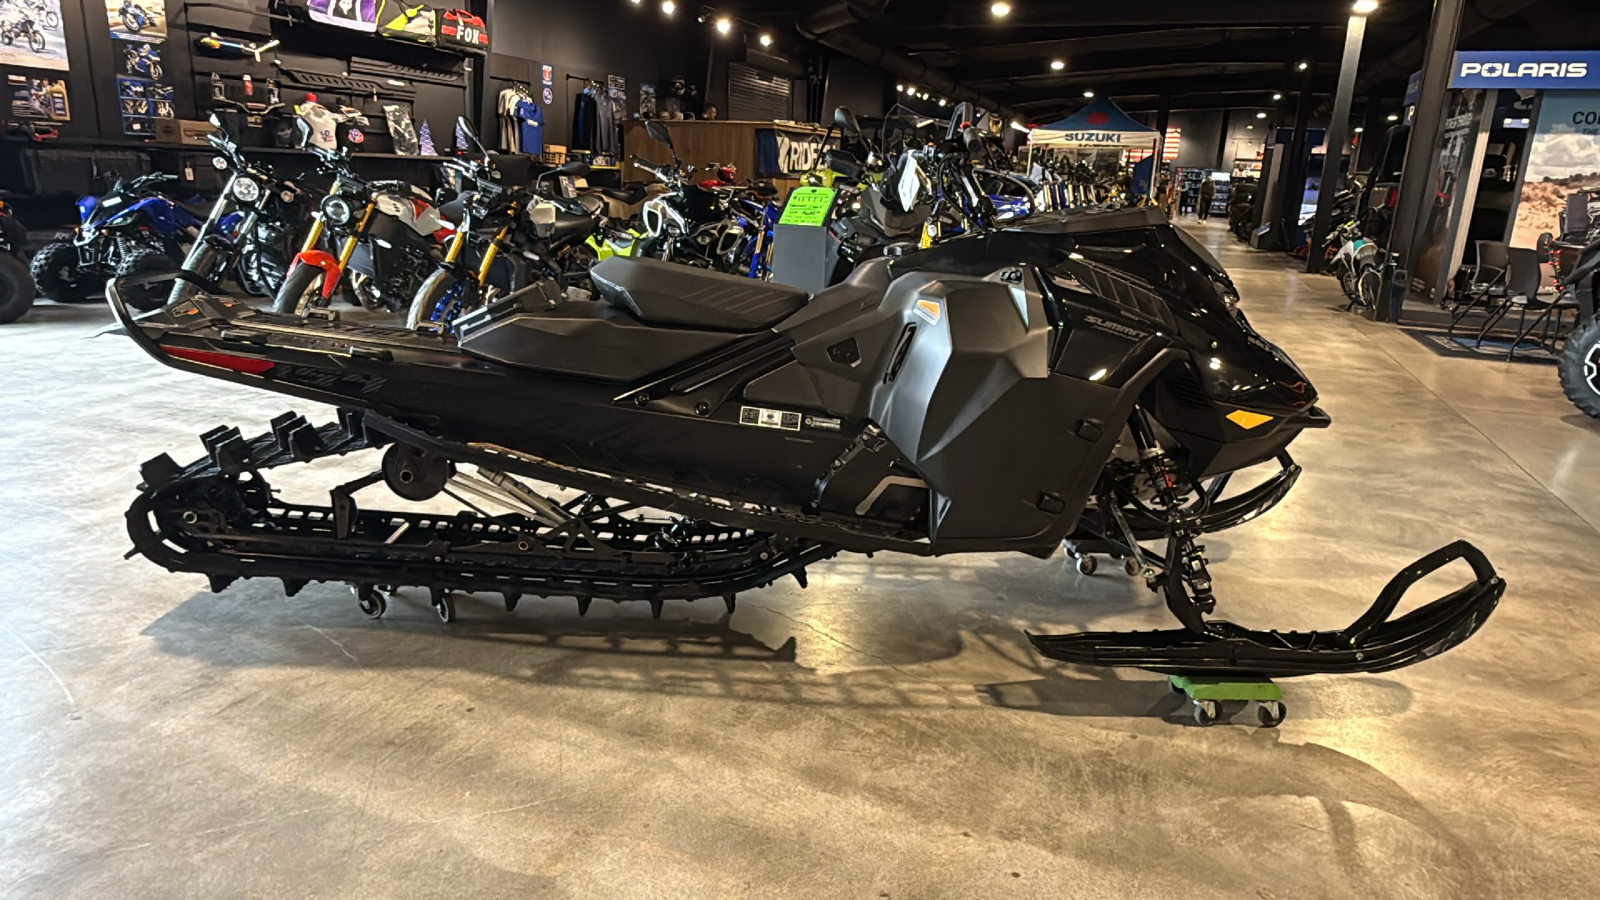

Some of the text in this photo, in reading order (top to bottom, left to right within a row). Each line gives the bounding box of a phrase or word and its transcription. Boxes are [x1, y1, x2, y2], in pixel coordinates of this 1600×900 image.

[456, 25, 480, 45] FOX
[1459, 62, 1588, 78] POLARIS
[1572, 111, 1600, 125] CO
[1064, 133, 1122, 143] SUZUKI
[1083, 315, 1149, 339] SUMMIT
